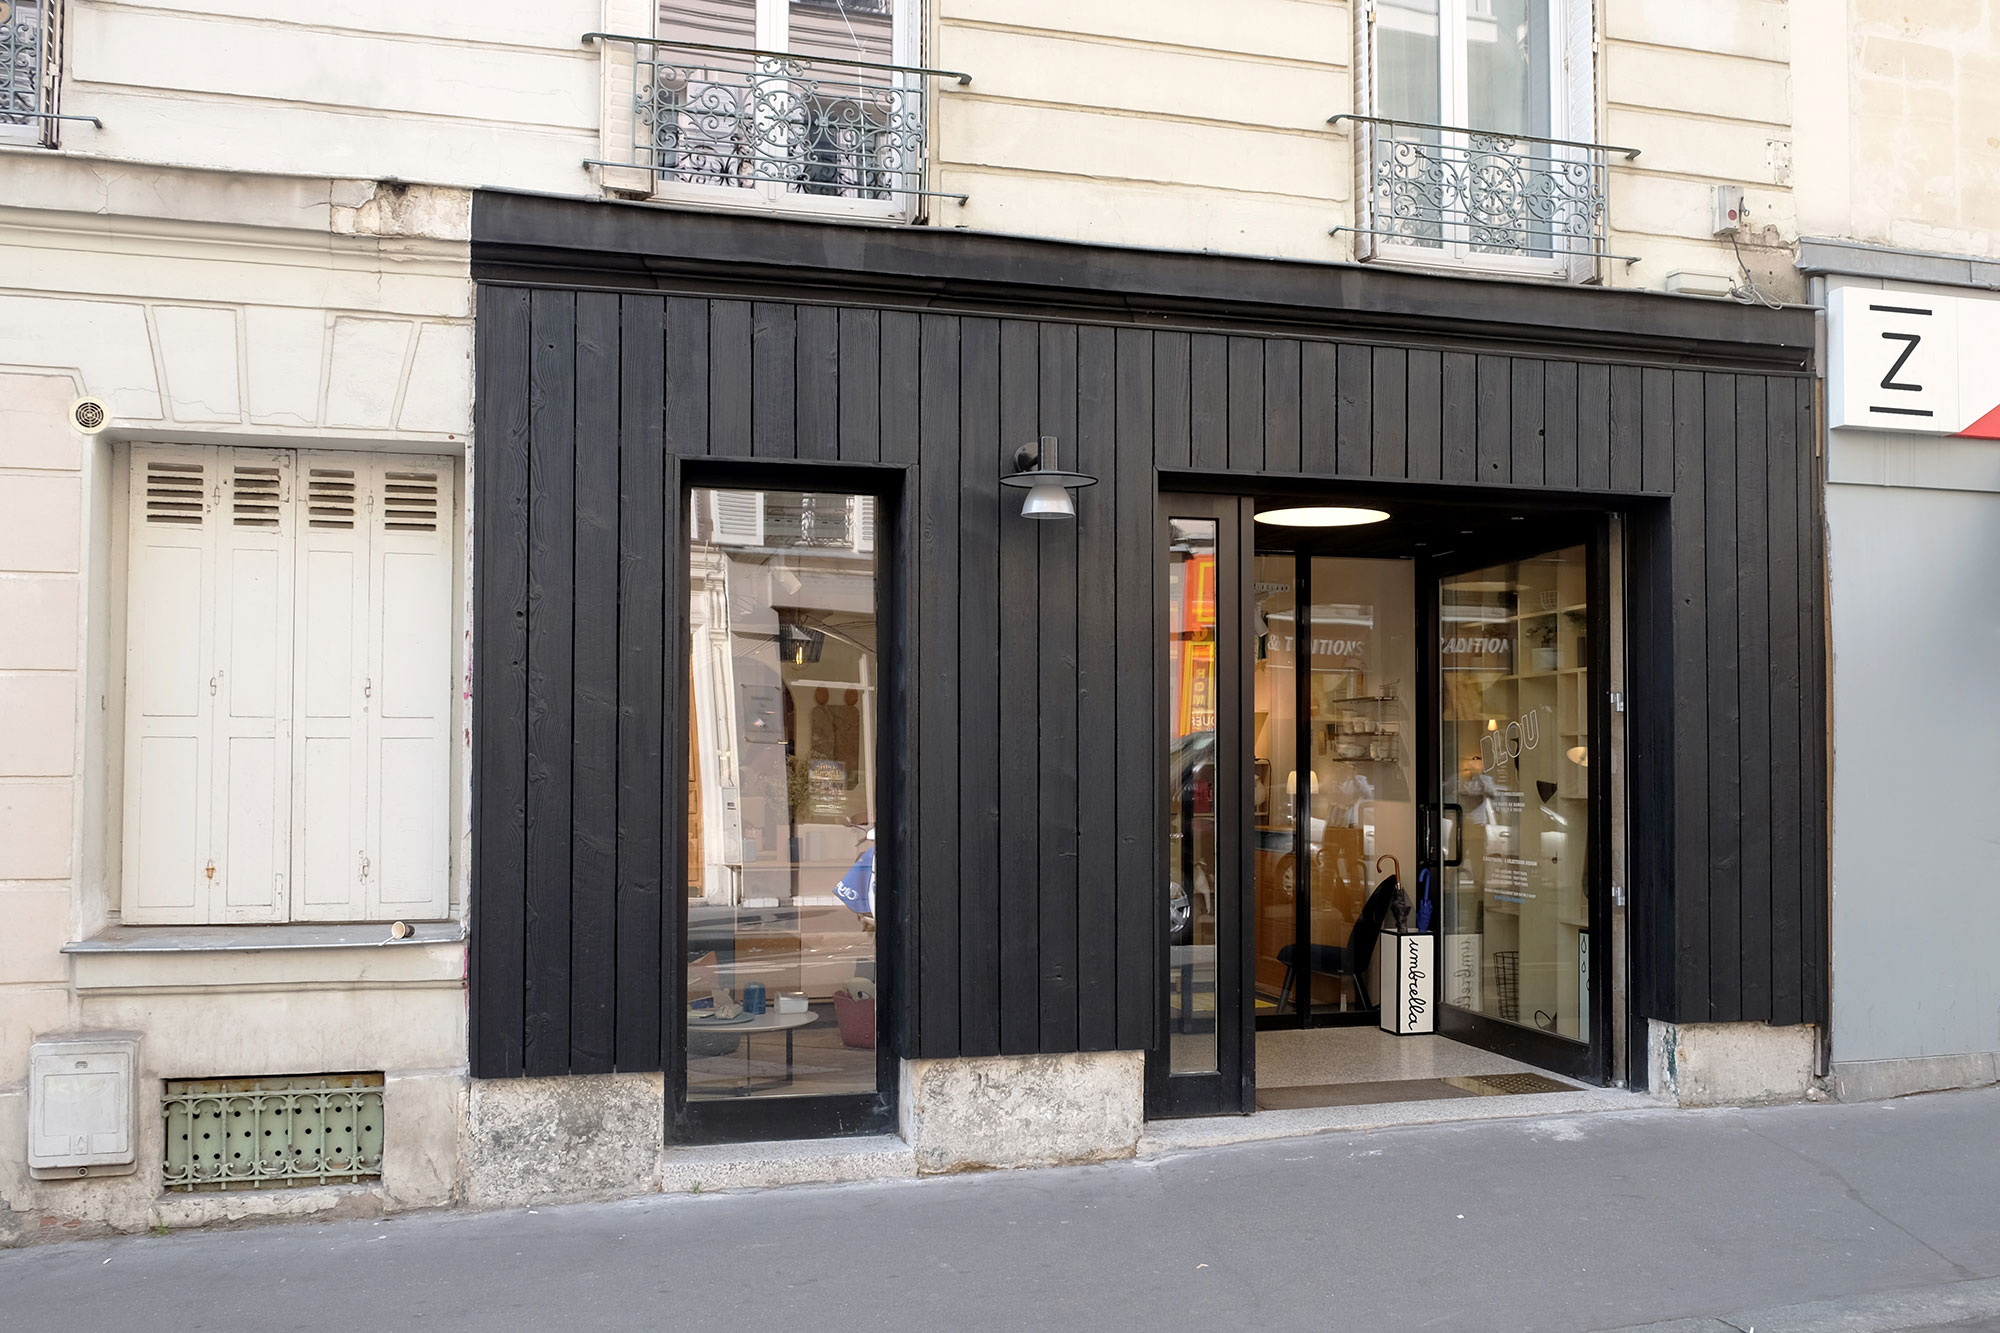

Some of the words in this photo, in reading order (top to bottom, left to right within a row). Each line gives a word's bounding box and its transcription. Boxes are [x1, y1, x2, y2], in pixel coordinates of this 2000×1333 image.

[1880, 331, 1923, 392] Z
[1267, 633, 1280, 652] &
[1480, 709, 1539, 773] BLOU
[1408, 937, 1427, 1031] umbrella
